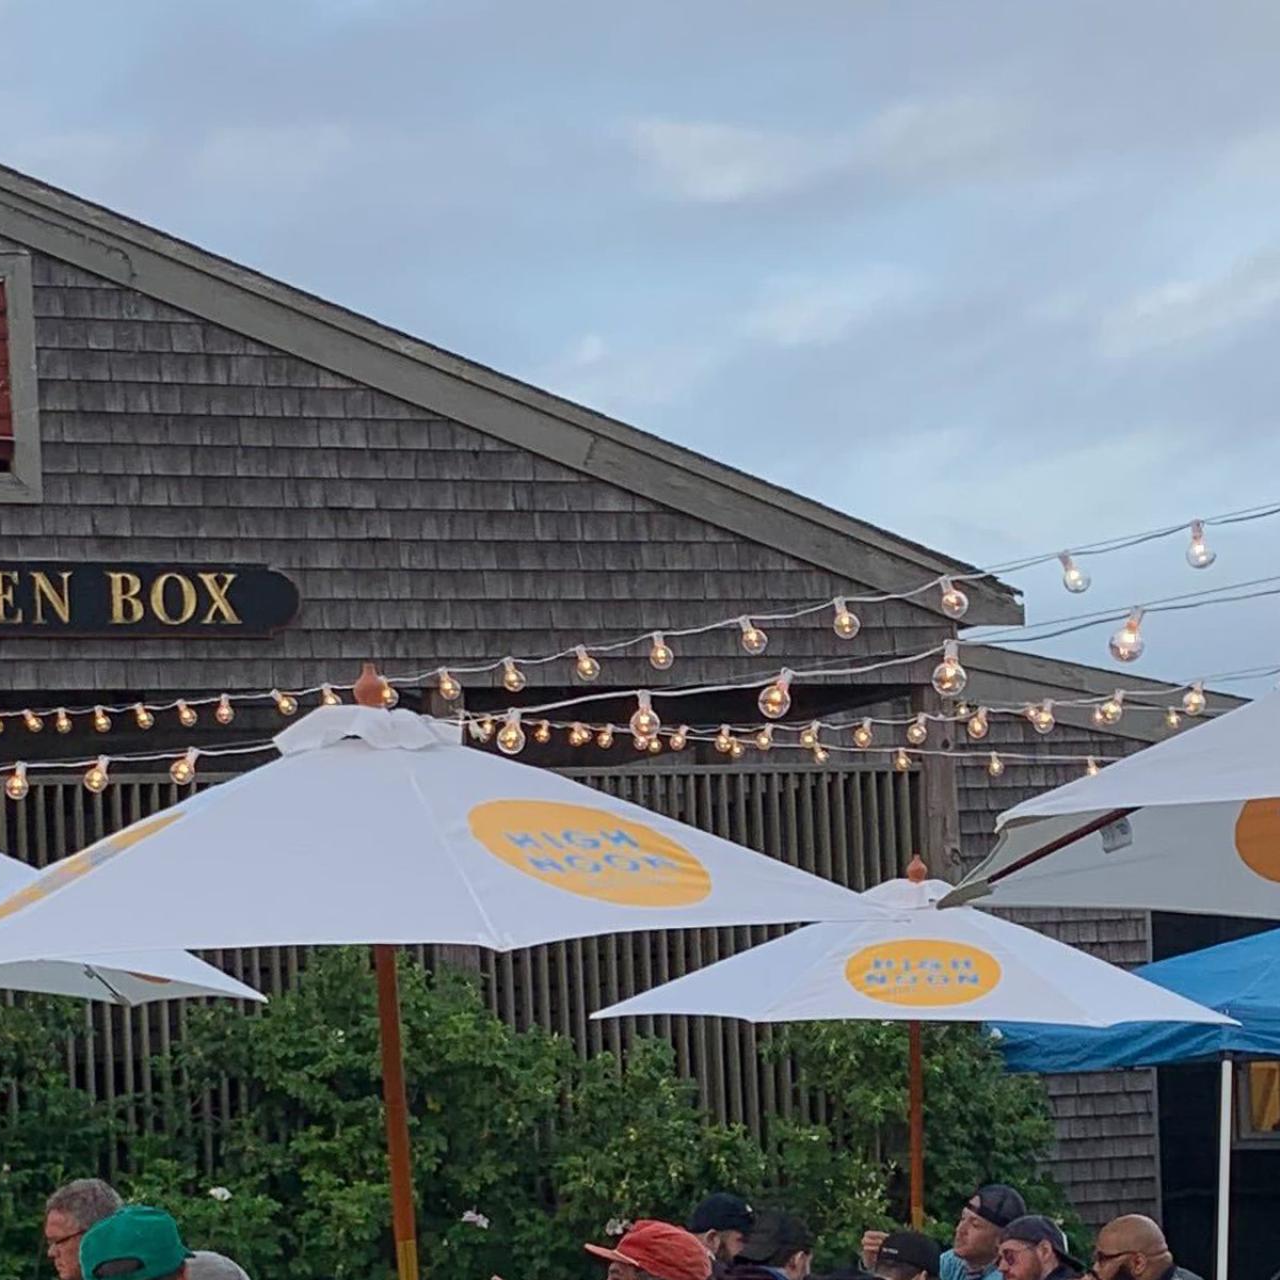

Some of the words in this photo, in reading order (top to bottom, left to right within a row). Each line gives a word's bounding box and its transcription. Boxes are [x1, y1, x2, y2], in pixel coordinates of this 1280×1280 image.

[104, 570, 244, 627] BOX
[505, 829, 640, 851] HIGH
[528, 853, 680, 874] NOON
[865, 973, 980, 985] NOON
